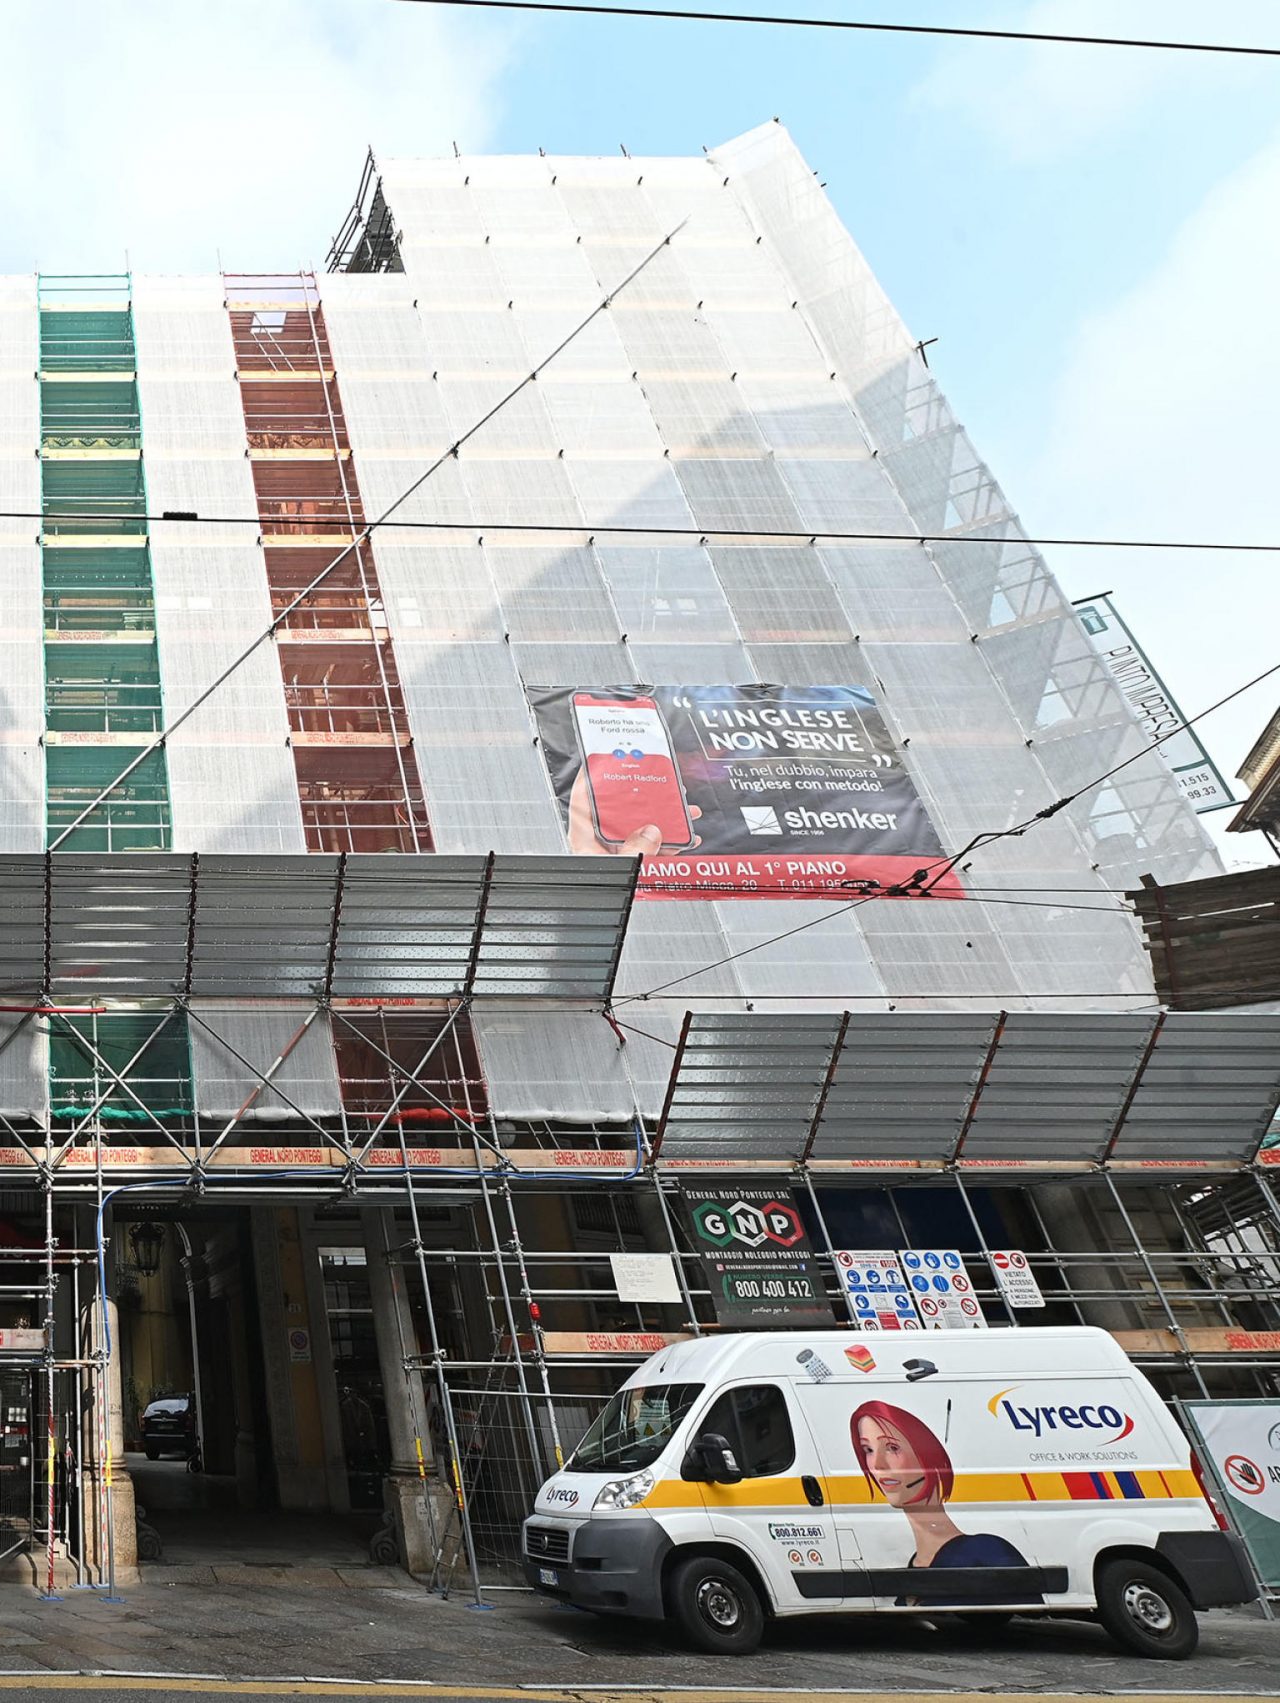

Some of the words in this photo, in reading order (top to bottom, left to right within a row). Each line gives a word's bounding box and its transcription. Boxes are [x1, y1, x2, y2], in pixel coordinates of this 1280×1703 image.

[588, 718, 621, 726] Roberto
[708, 732, 779, 751] NON
[780, 730, 864, 752] SERVE
[603, 773, 632, 781] Robert
[723, 765, 748, 778] Tu,
[750, 764, 773, 776] nel
[775, 764, 829, 778] dubbio,
[829, 766, 878, 779] impara
[730, 778, 792, 793] l'inglese
[795, 780, 822, 790] con
[825, 780, 884, 792] metodo!
[783, 806, 898, 830] shenker
[639, 862, 691, 877] IAMO
[696, 861, 731, 877] QUI
[736, 861, 761, 876] AL
[765, 861, 782, 875] 1°
[787, 861, 847, 875] PIANO
[741, 879, 758, 891] 20
[793, 879, 817, 890] 011
[109, 1149, 138, 1163] PONTEGGI
[250, 1149, 277, 1163] GENERAL
[278, 1149, 293, 1163] NORD
[294, 1149, 323, 1163] PONTEGGI
[370, 1150, 395, 1164] GENERAL
[413, 1150, 441, 1164] PONTEGGI
[555, 1151, 580, 1166] GENERAL
[581, 1151, 596, 1166] NORD
[597, 1151, 627, 1166] PONTEGGI
[685, 1191, 718, 1200] GENERAL
[719, 1190, 739, 1200] NORD
[740, 1190, 776, 1200] PONTEGGI
[704, 1251, 743, 1260] MONTAGGIO
[744, 1251, 778, 1260] NOLEGGIO
[778, 1251, 811, 1260] PONTEGGI
[735, 1280, 760, 1298] 800
[762, 1280, 787, 1298] 400
[788, 1280, 812, 1298] 412
[1002, 1400, 1123, 1437] Lyreco
[1029, 1453, 1057, 1462] OFFICE
[1058, 1453, 1065, 1461] &
[1065, 1453, 1091, 1461] WORK
[1092, 1452, 1138, 1461] SOLUTIONS
[546, 1486, 578, 1503] Lyreco
[775, 1527, 822, 1538] 800.812.661
